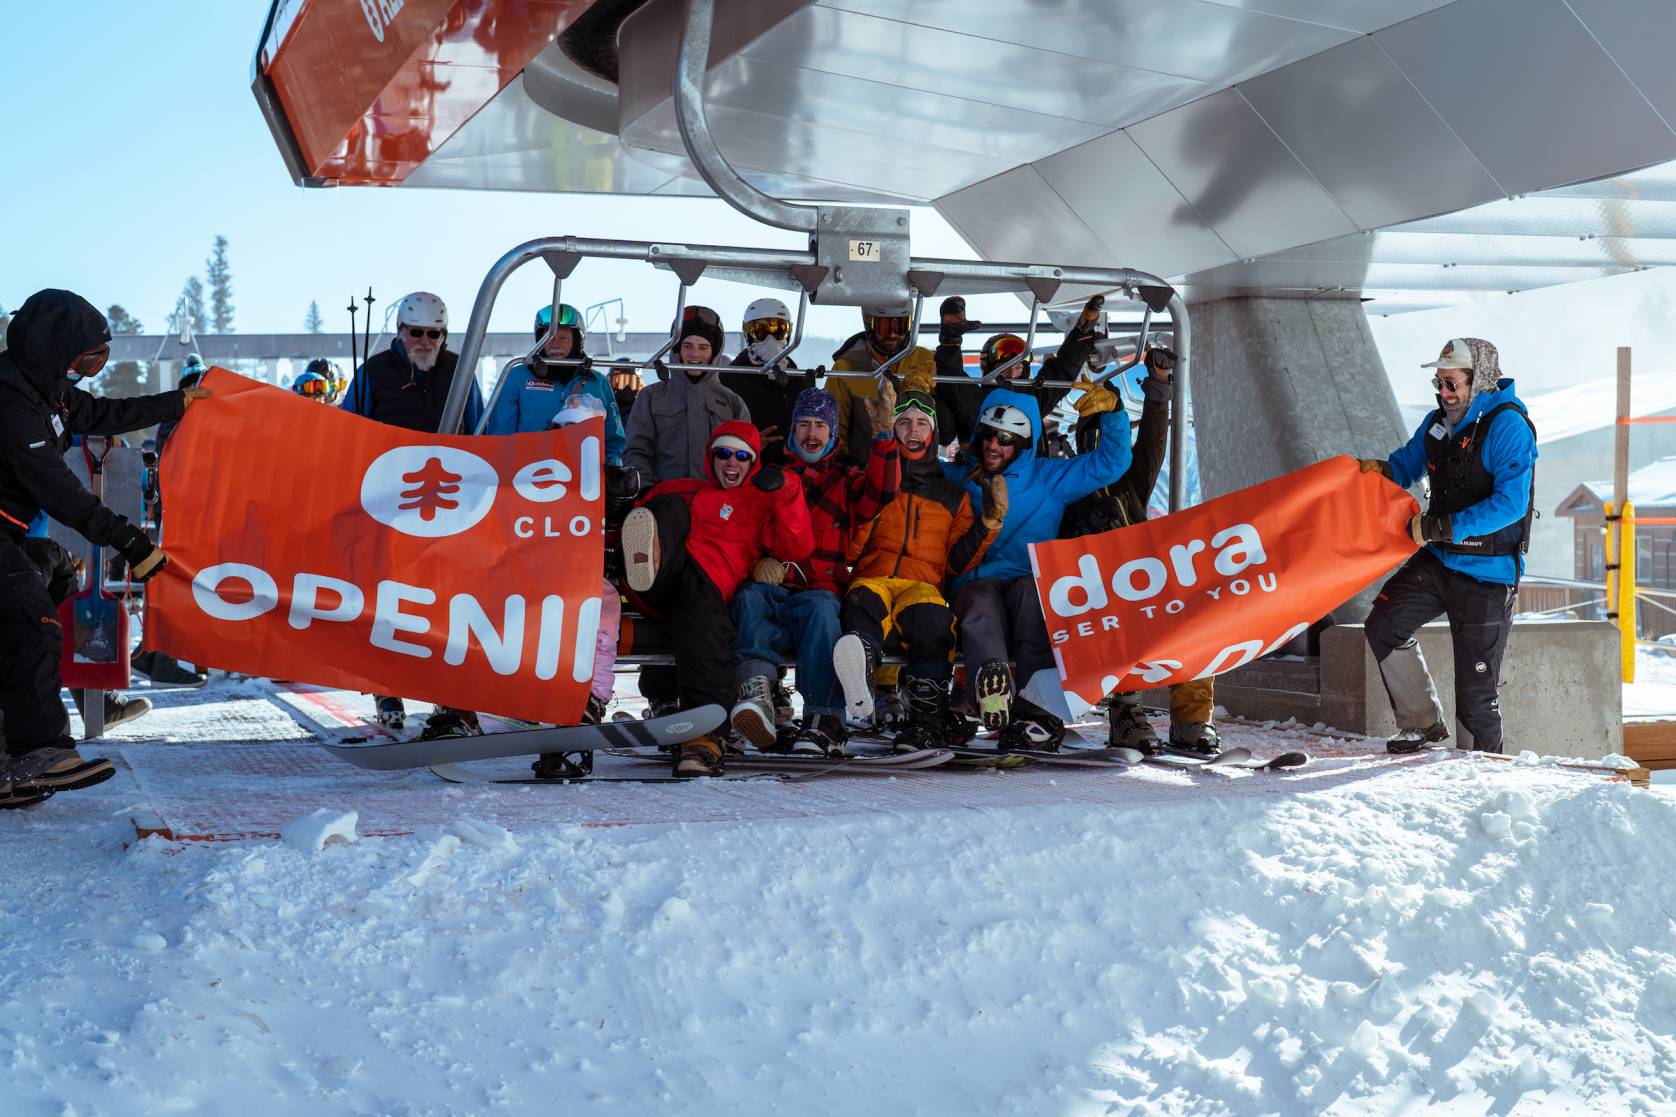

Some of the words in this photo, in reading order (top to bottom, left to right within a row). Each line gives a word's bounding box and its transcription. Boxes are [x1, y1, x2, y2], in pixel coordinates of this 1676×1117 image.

[857, 242, 873, 256] 67
[512, 435, 601, 503] el
[514, 515, 605, 538] CLO
[1048, 523, 1268, 618] dora
[191, 562, 603, 683] OPENI
[1052, 615, 1120, 644] SER
[1140, 599, 1185, 619] TO
[1205, 572, 1278, 600] YOU
